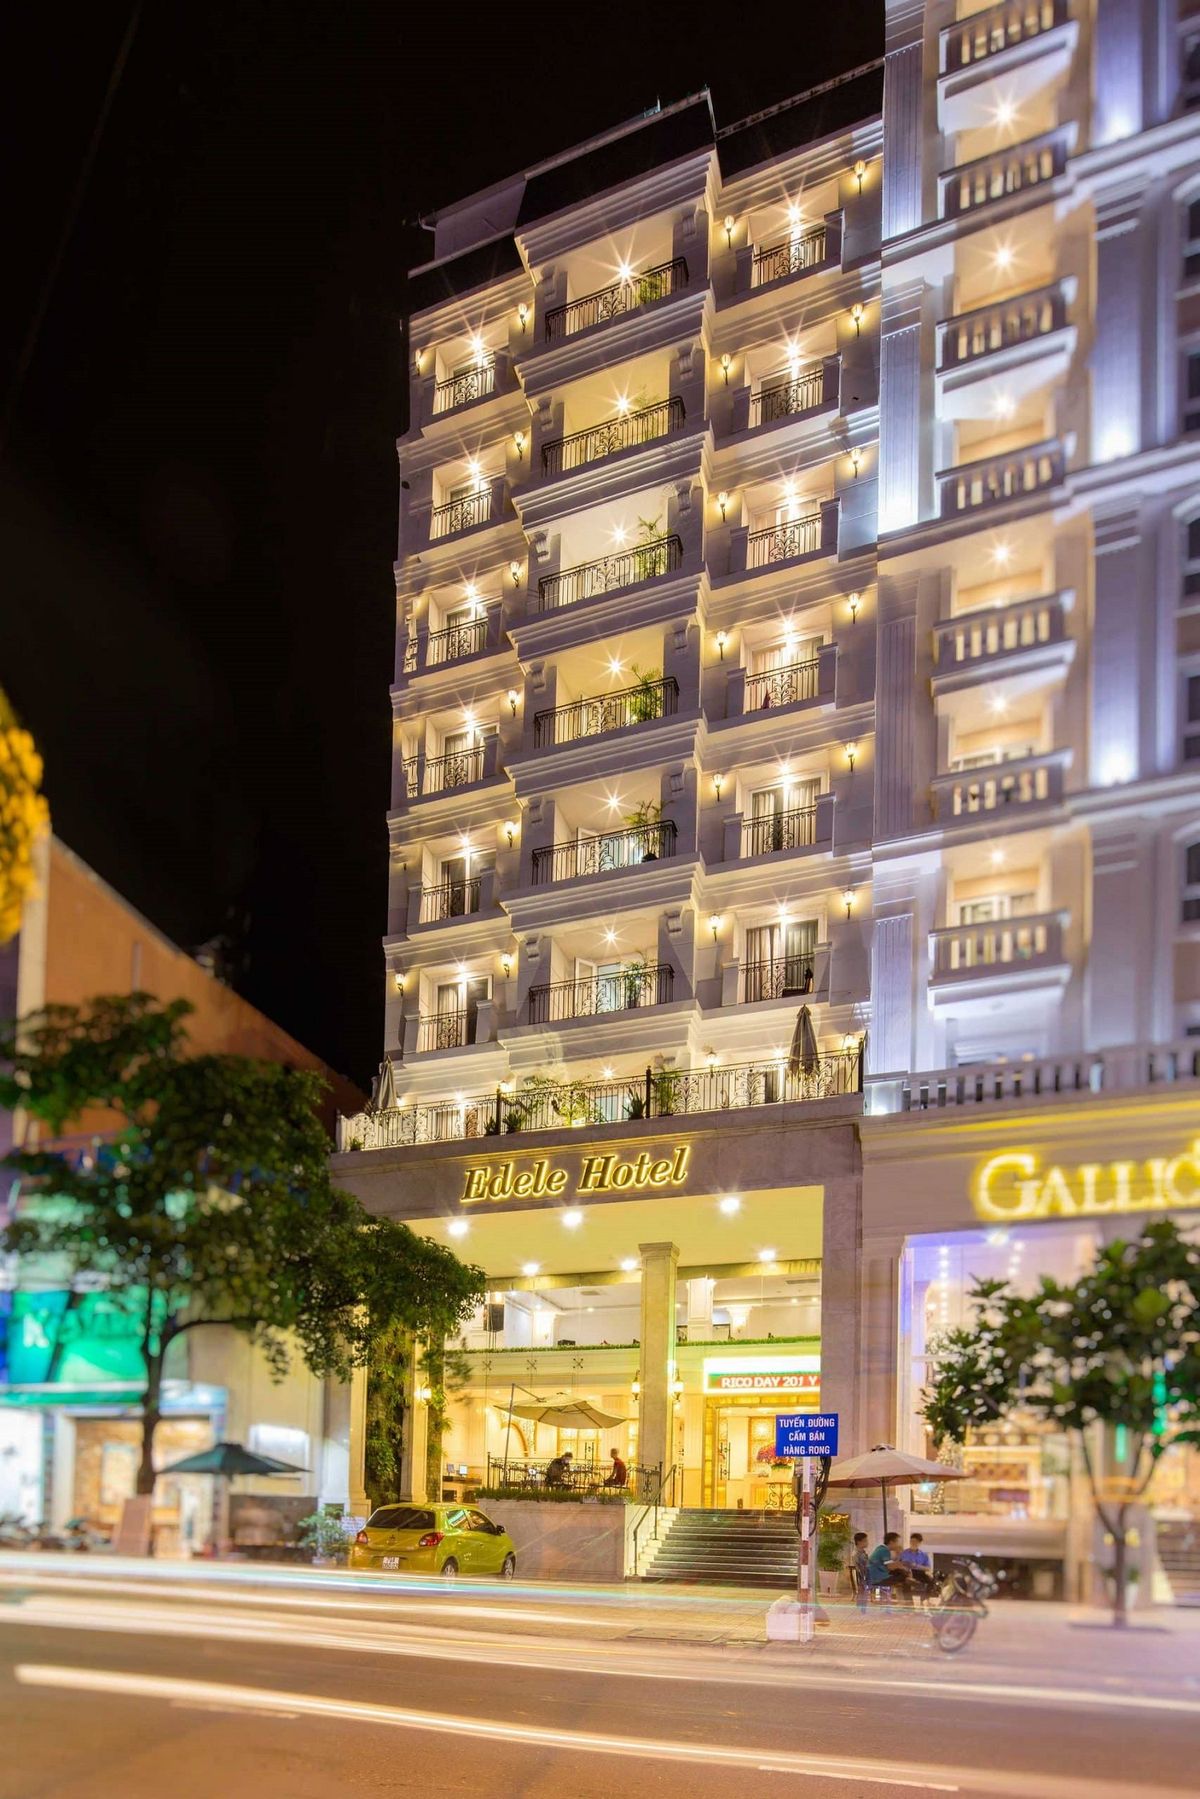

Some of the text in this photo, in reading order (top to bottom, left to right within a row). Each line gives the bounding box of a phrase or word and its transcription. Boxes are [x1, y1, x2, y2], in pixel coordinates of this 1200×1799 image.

[460, 1145, 690, 1202] Edele Hotel
[754, 1376, 780, 1387] DAY
[788, 1429, 825, 1441] CẤM BÁN
[808, 1445, 830, 1455] RONG
